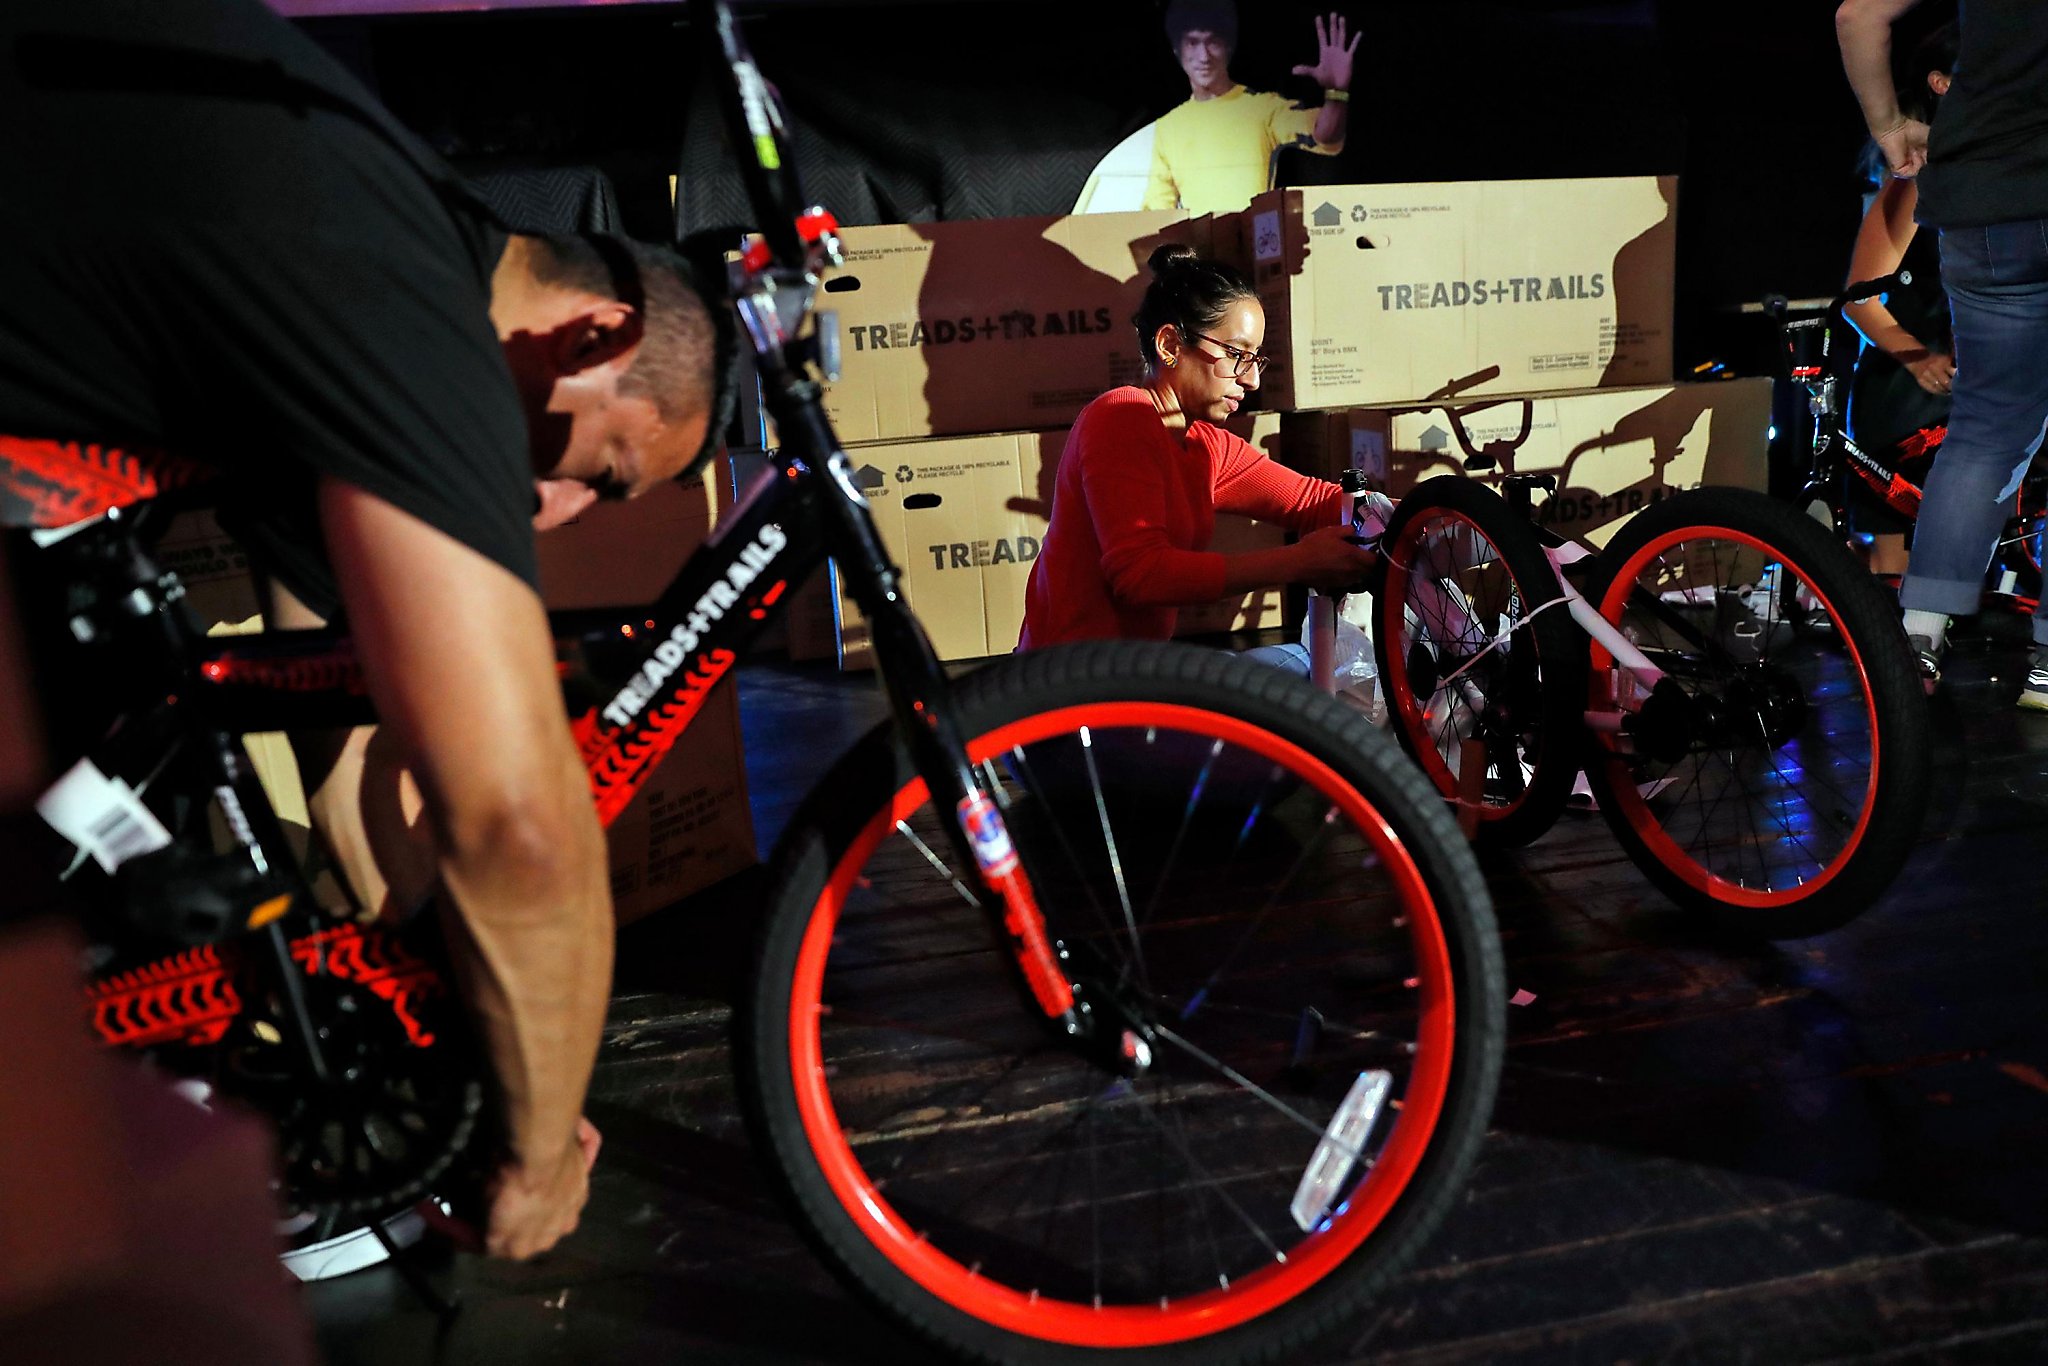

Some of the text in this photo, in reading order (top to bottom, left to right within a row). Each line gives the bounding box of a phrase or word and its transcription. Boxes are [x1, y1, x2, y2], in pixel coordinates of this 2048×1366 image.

[1378, 274, 1604, 311] TREADS+TRAILS
[849, 308, 1111, 351] TREADS+TRAILS
[976, 461, 1010, 469] RECYCLABLE
[929, 534, 1048, 570] TREAD
[602, 522, 787, 727] TREADS+TRAILS
